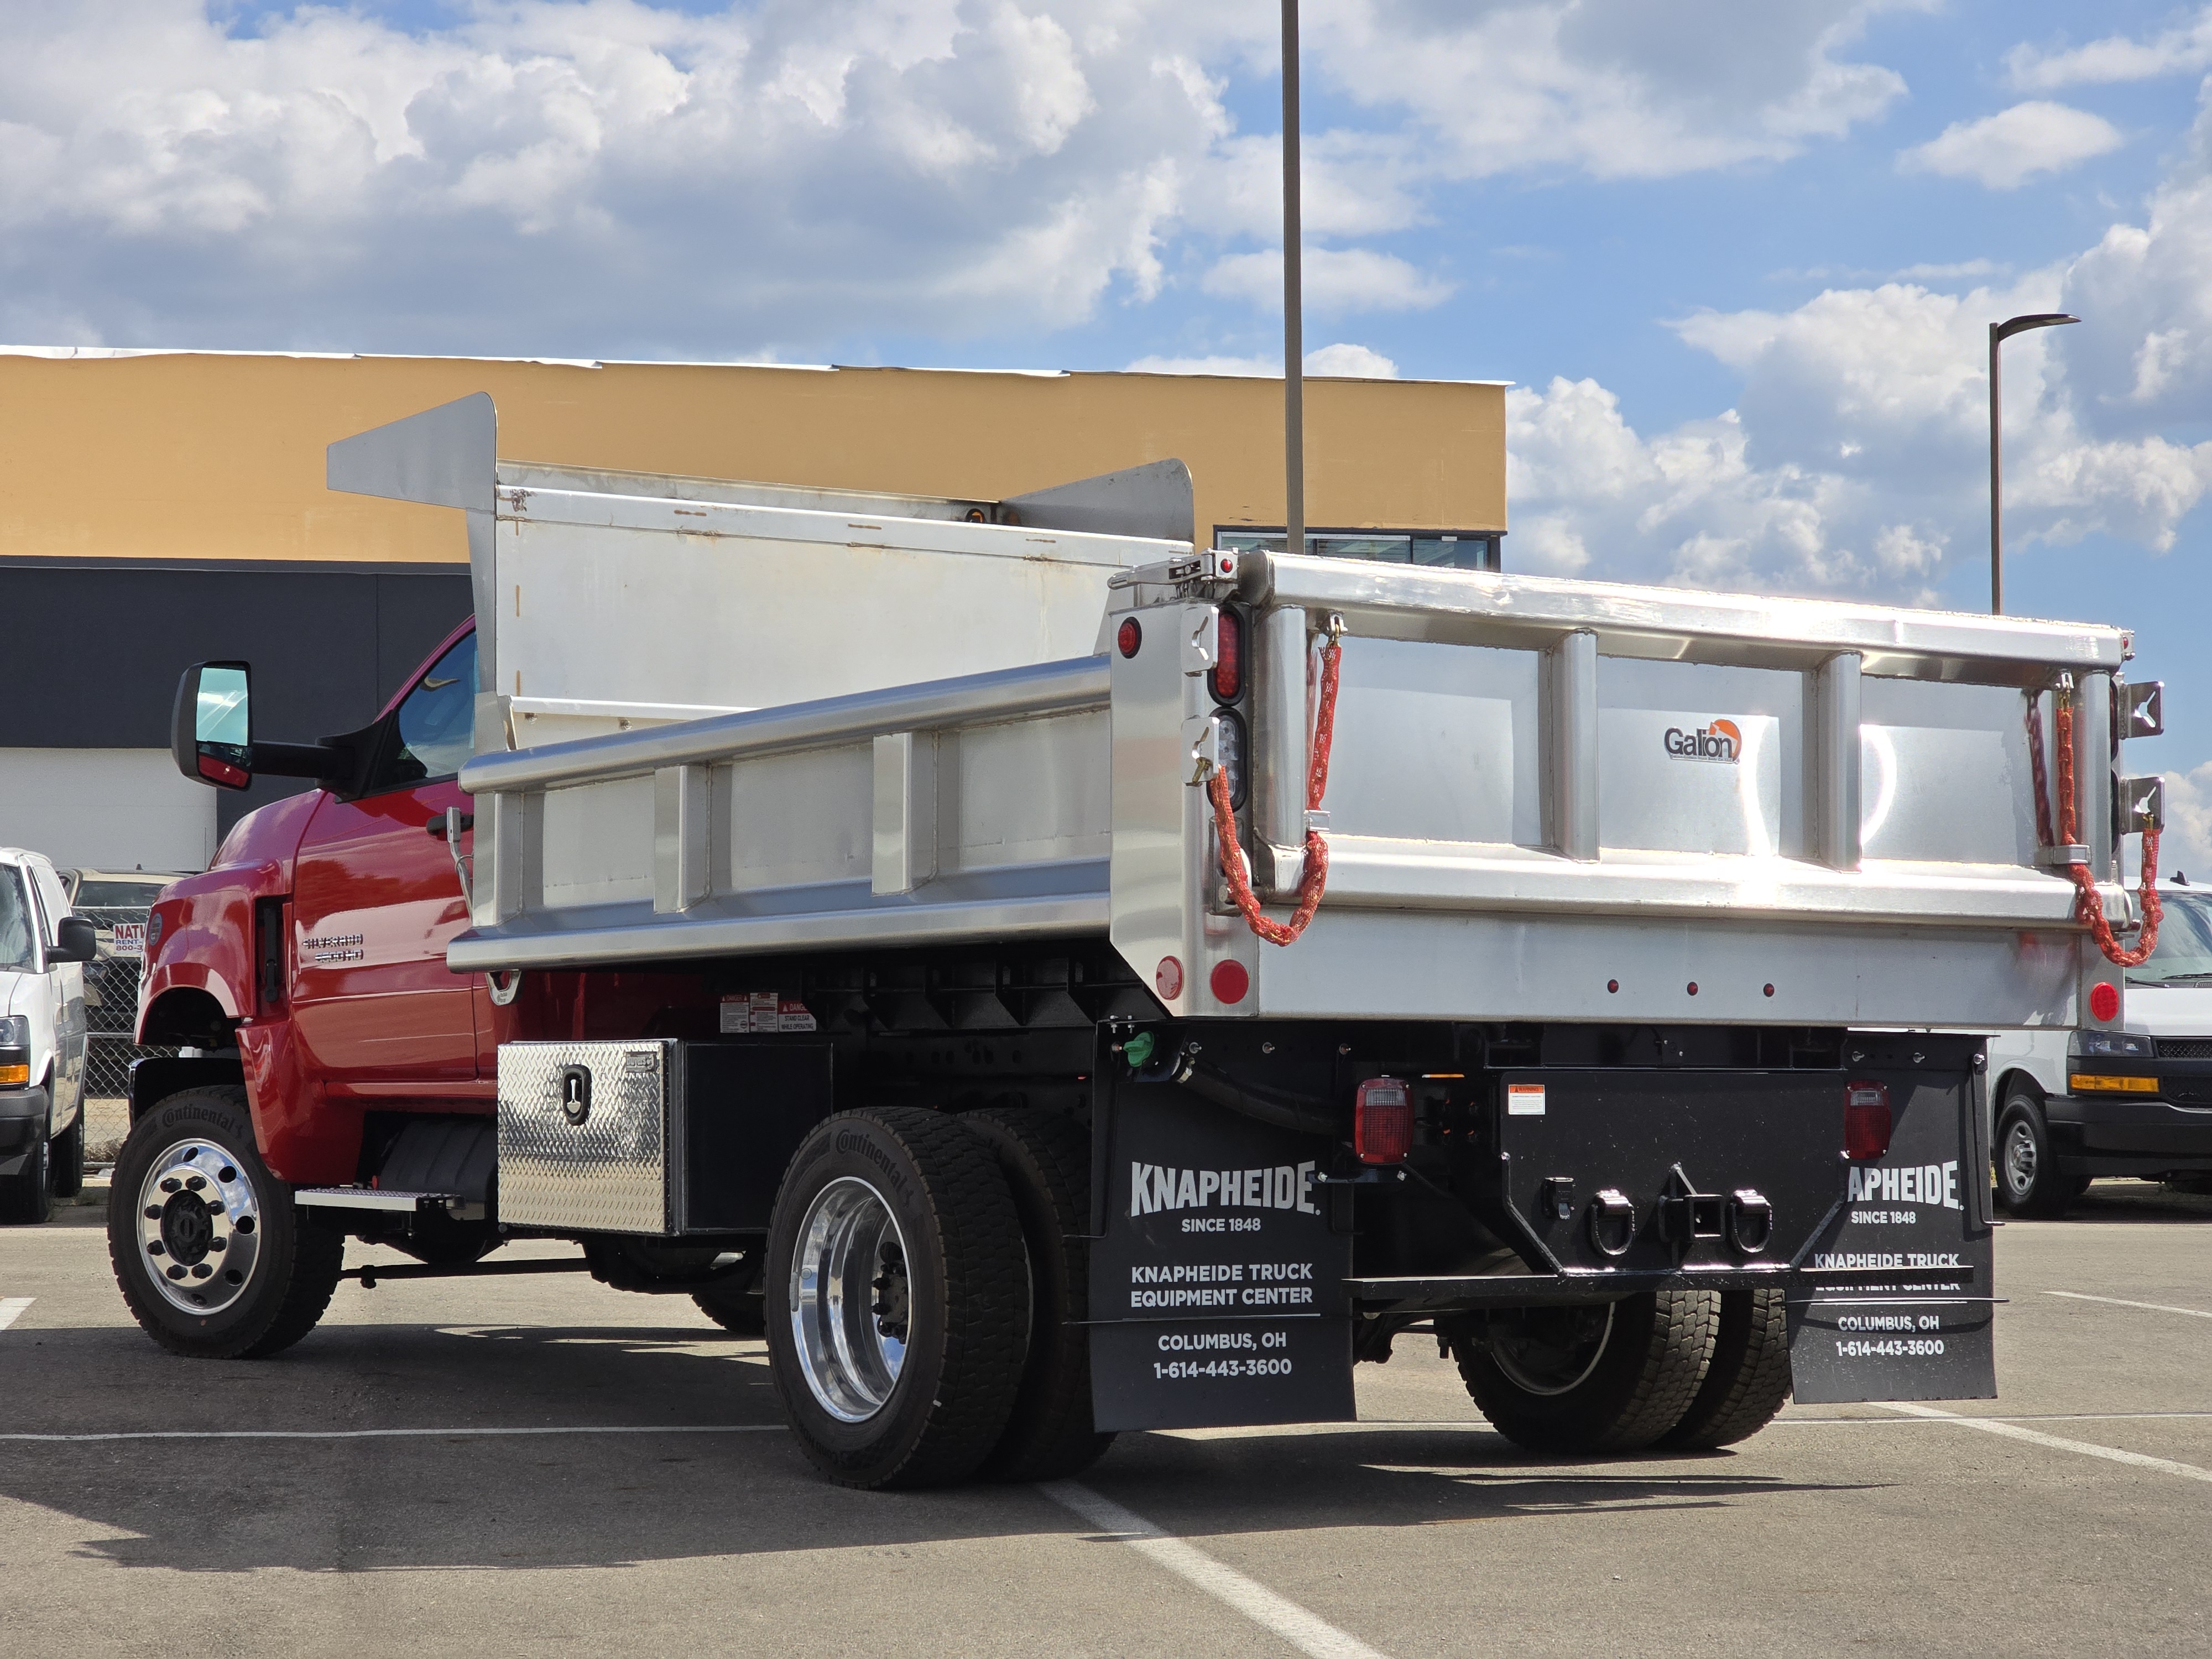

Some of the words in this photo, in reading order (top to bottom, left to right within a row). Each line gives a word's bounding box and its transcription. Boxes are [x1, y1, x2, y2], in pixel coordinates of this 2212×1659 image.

[1665, 728, 1732, 758] Galion
[115, 925, 144, 938] NATI
[302, 934, 363, 949] SILVERADO
[162, 1104, 236, 1132] Continental
[836, 1129, 907, 1193] Continental
[1131, 1161, 1315, 1217] KNAPHEIDE
[1848, 1160, 1959, 1209] APHEIDE
[1181, 1218, 1225, 1232] SINCE
[1229, 1218, 1261, 1232] 1848
[1851, 1211, 1887, 1224] SINCE
[1890, 1211, 1916, 1224] 1848
[1814, 1254, 1903, 1269] KNAPHEIDE
[1907, 1254, 1959, 1267] TRUCK
[1132, 1265, 1243, 1283] KNAPHEIDE
[1249, 1264, 1313, 1281] TRUCK
[1131, 1289, 1237, 1307] EQUIPMENT
[1242, 1287, 1313, 1305] CENTER
[1838, 1316, 1916, 1333] COLUMBUS,
[1919, 1316, 1939, 1329] OH
[1158, 1333, 1257, 1351] COLUMBUS,
[1261, 1332, 1286, 1347] OH
[1836, 1340, 1944, 1356] 1-614-443-3600
[1154, 1358, 1292, 1379] 1-614-443-3600
